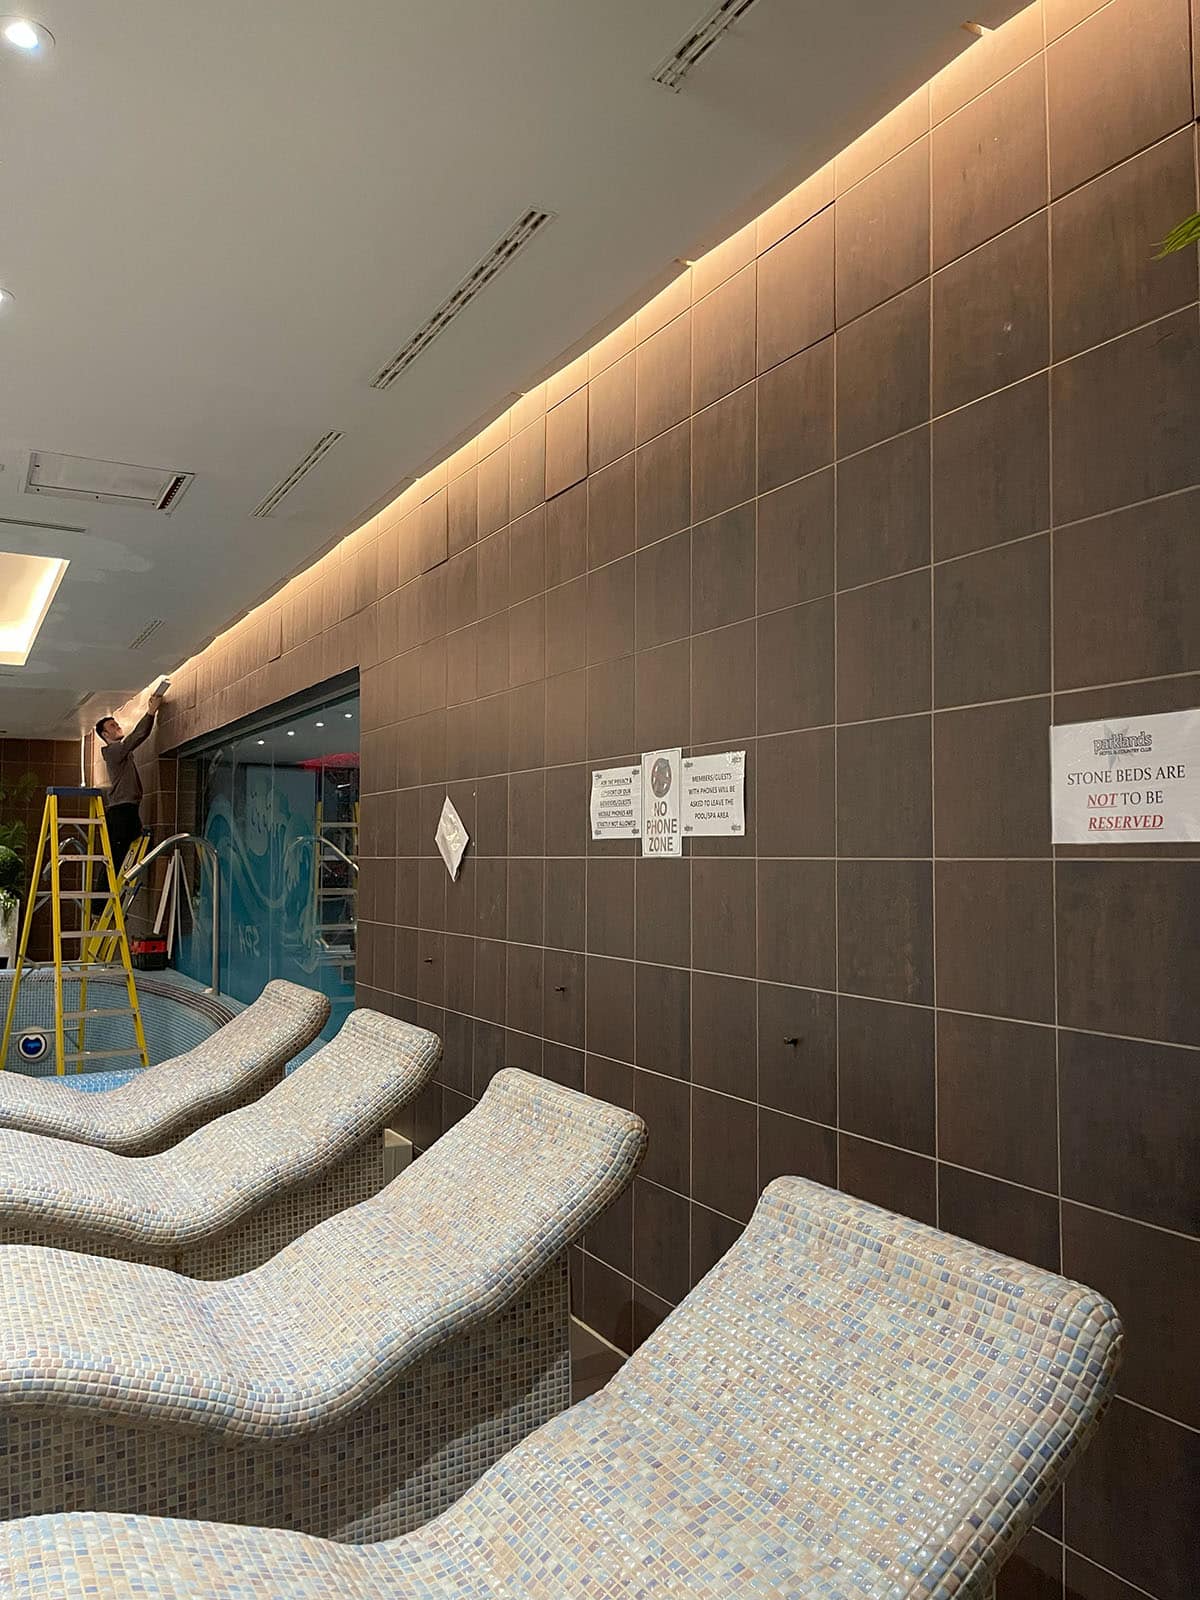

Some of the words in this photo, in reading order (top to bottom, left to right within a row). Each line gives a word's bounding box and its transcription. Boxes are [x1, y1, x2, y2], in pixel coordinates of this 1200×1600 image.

[1094, 731, 1152, 755] parklands
[1067, 771, 1112, 785] STONE
[1116, 767, 1152, 782] BEDS
[1156, 765, 1186, 780] ARE
[700, 786, 717, 794] PHONES
[729, 785, 735, 793] BE
[704, 799, 710, 807] TO
[711, 798, 724, 806] LEAVE
[725, 798, 734, 806] THE
[1088, 793, 1119, 807] NOT
[1120, 792, 1142, 805] TO
[1146, 790, 1164, 804] BE
[654, 801, 667, 816] NO
[717, 811, 729, 819] AREA
[646, 819, 677, 835] PHONE
[1088, 814, 1164, 830] RESERVED
[648, 836, 673, 852] ZONE
